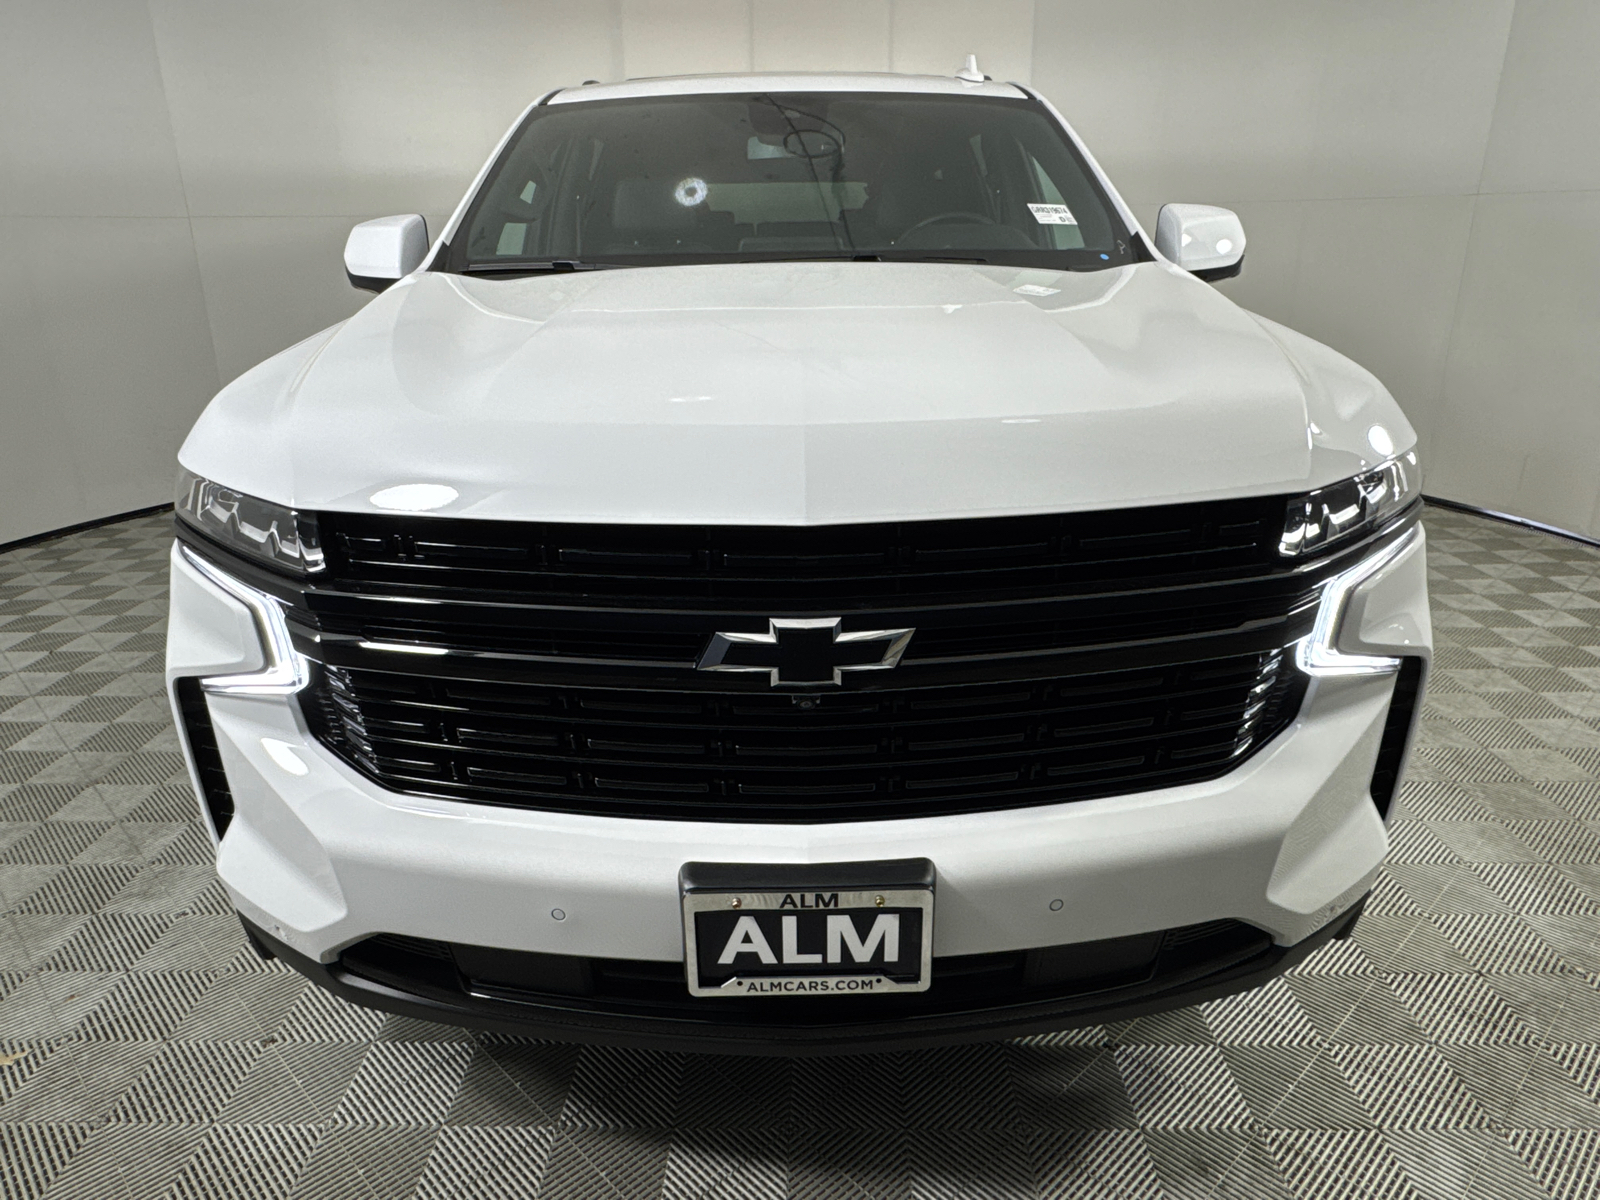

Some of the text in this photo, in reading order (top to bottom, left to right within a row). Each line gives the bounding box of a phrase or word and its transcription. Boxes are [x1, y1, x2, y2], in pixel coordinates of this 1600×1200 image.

[780, 893, 839, 909] ALM
[717, 913, 900, 964] ALM
[747, 979, 874, 993] ALMCARS.COM
